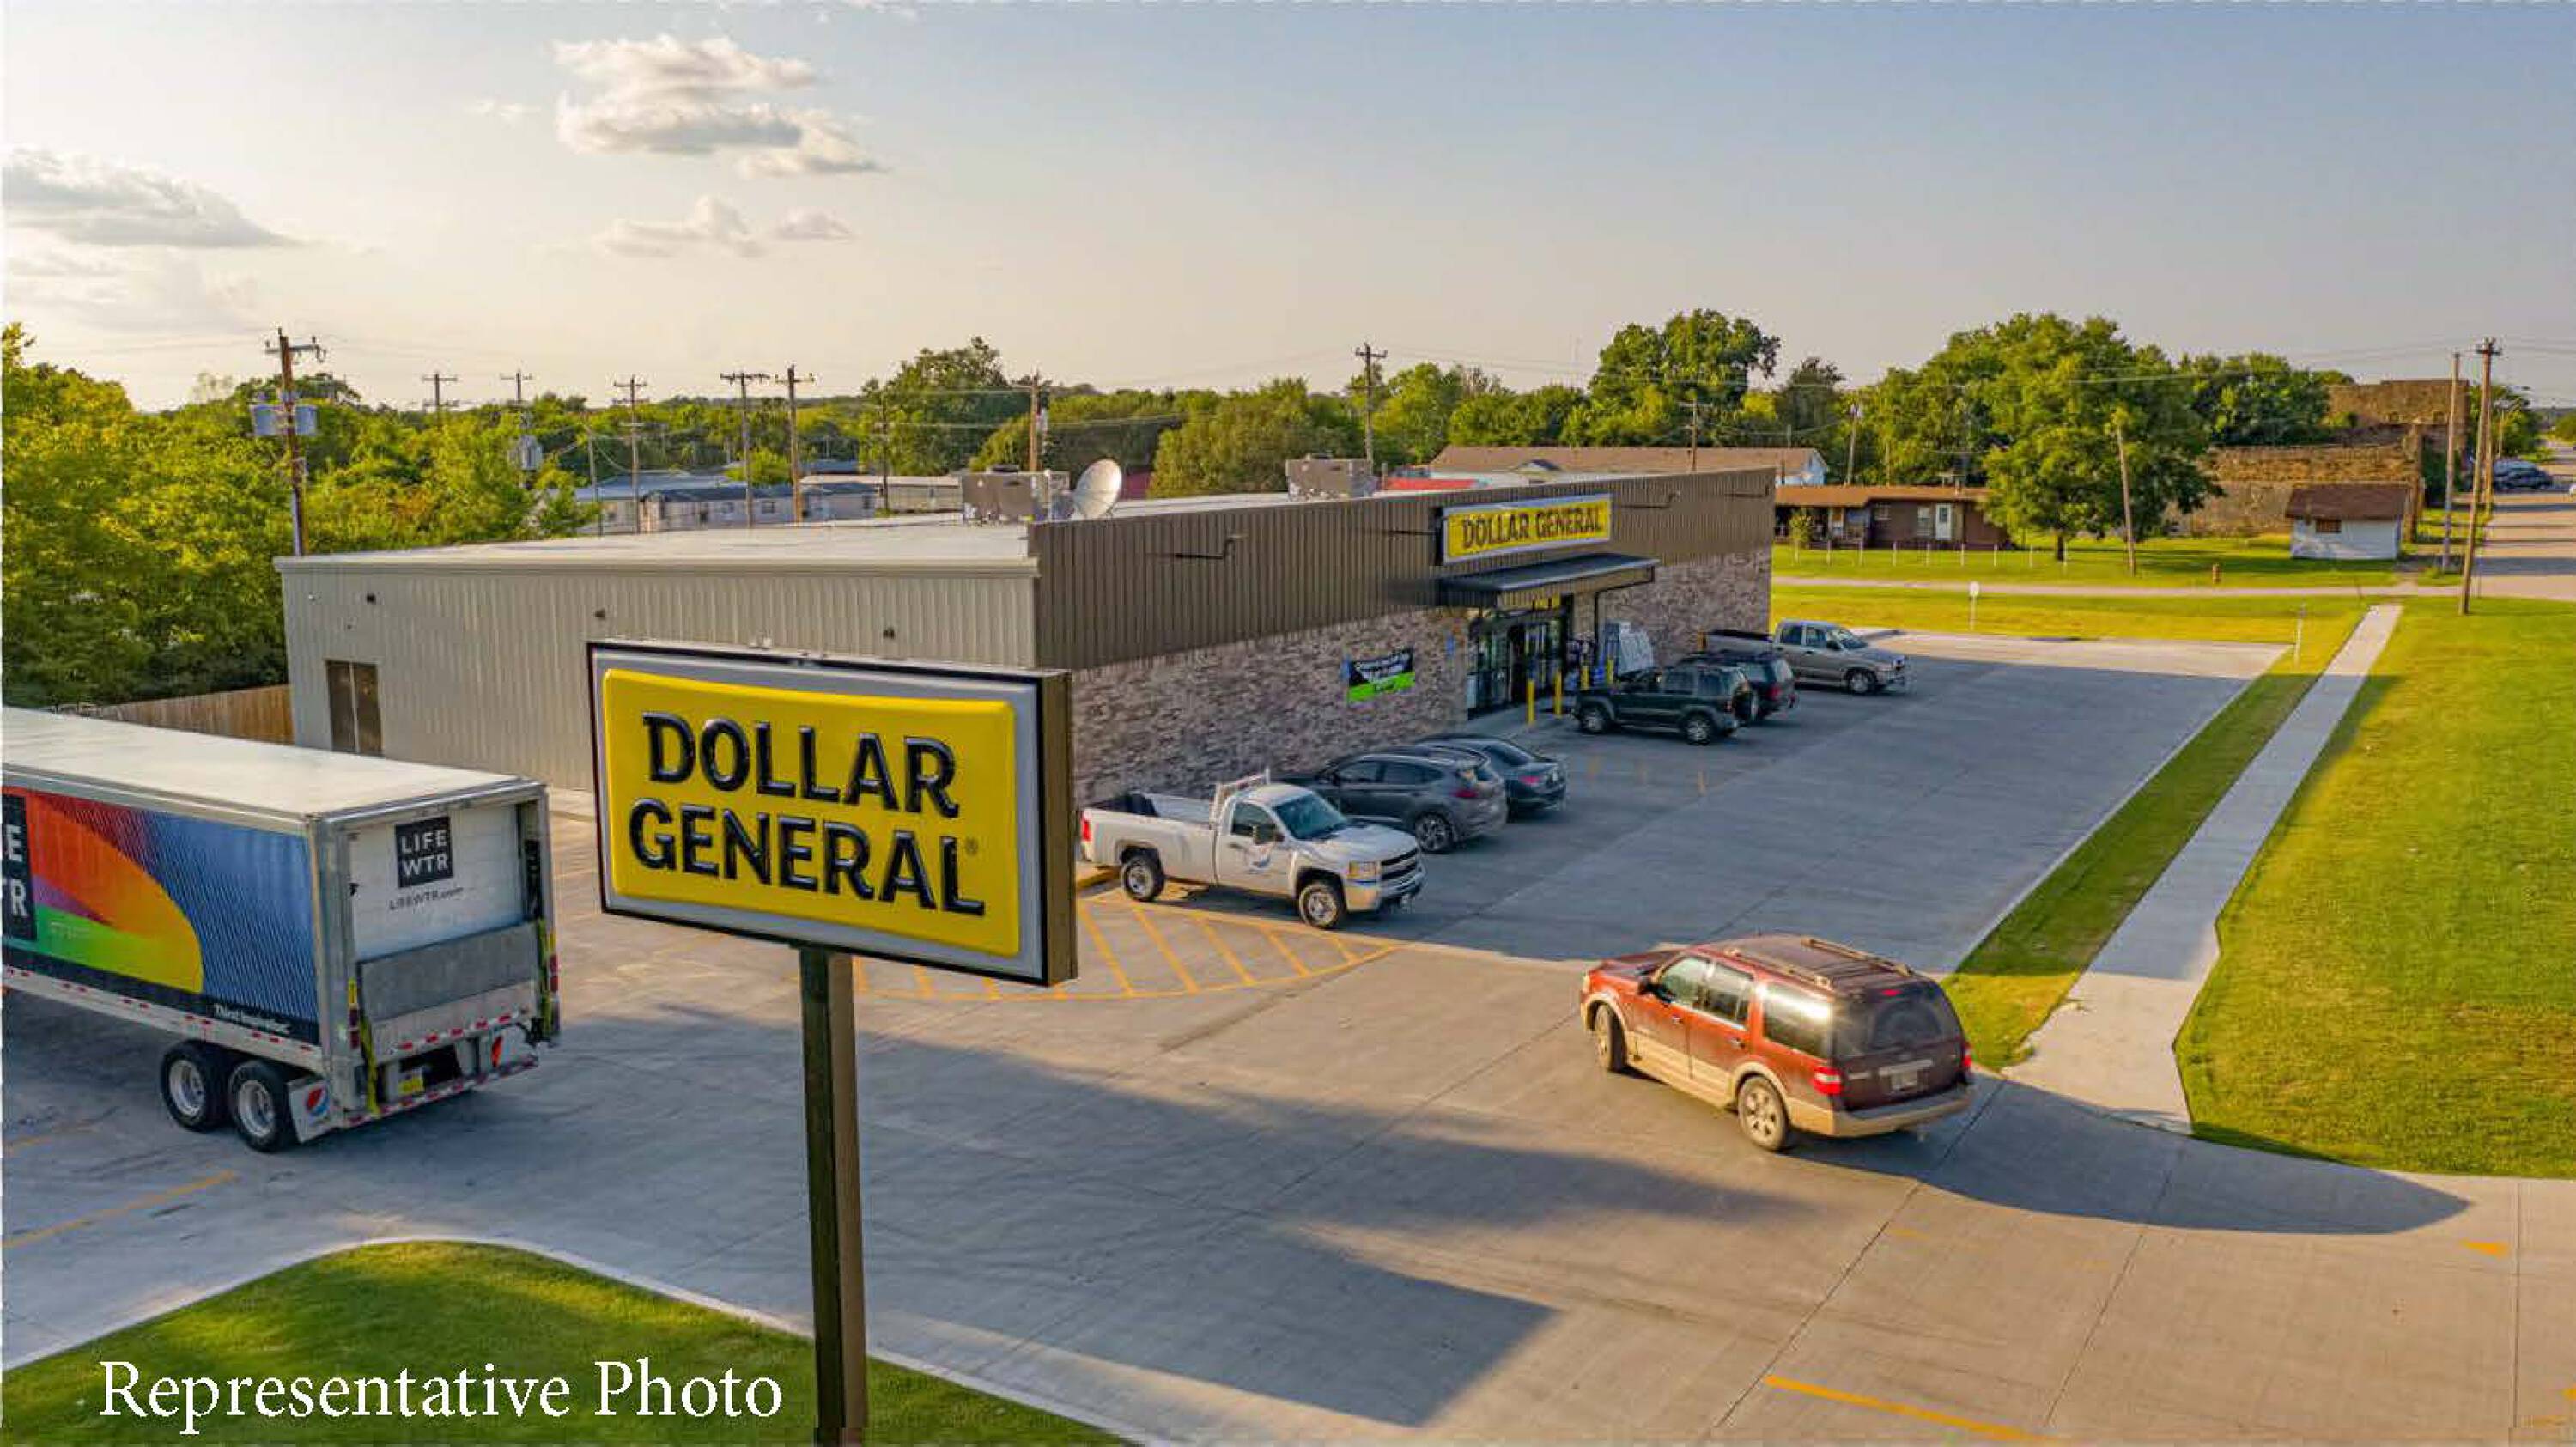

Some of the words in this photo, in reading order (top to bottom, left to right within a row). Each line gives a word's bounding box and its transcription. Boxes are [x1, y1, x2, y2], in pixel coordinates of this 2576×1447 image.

[1461, 513, 1529, 549] DOLLAR
[1535, 505, 1601, 538] GENERAL
[642, 712, 960, 819] DOLLAR
[400, 829, 447, 854] LIFE
[629, 798, 986, 916] GENERAL
[401, 853, 448, 877] WTR
